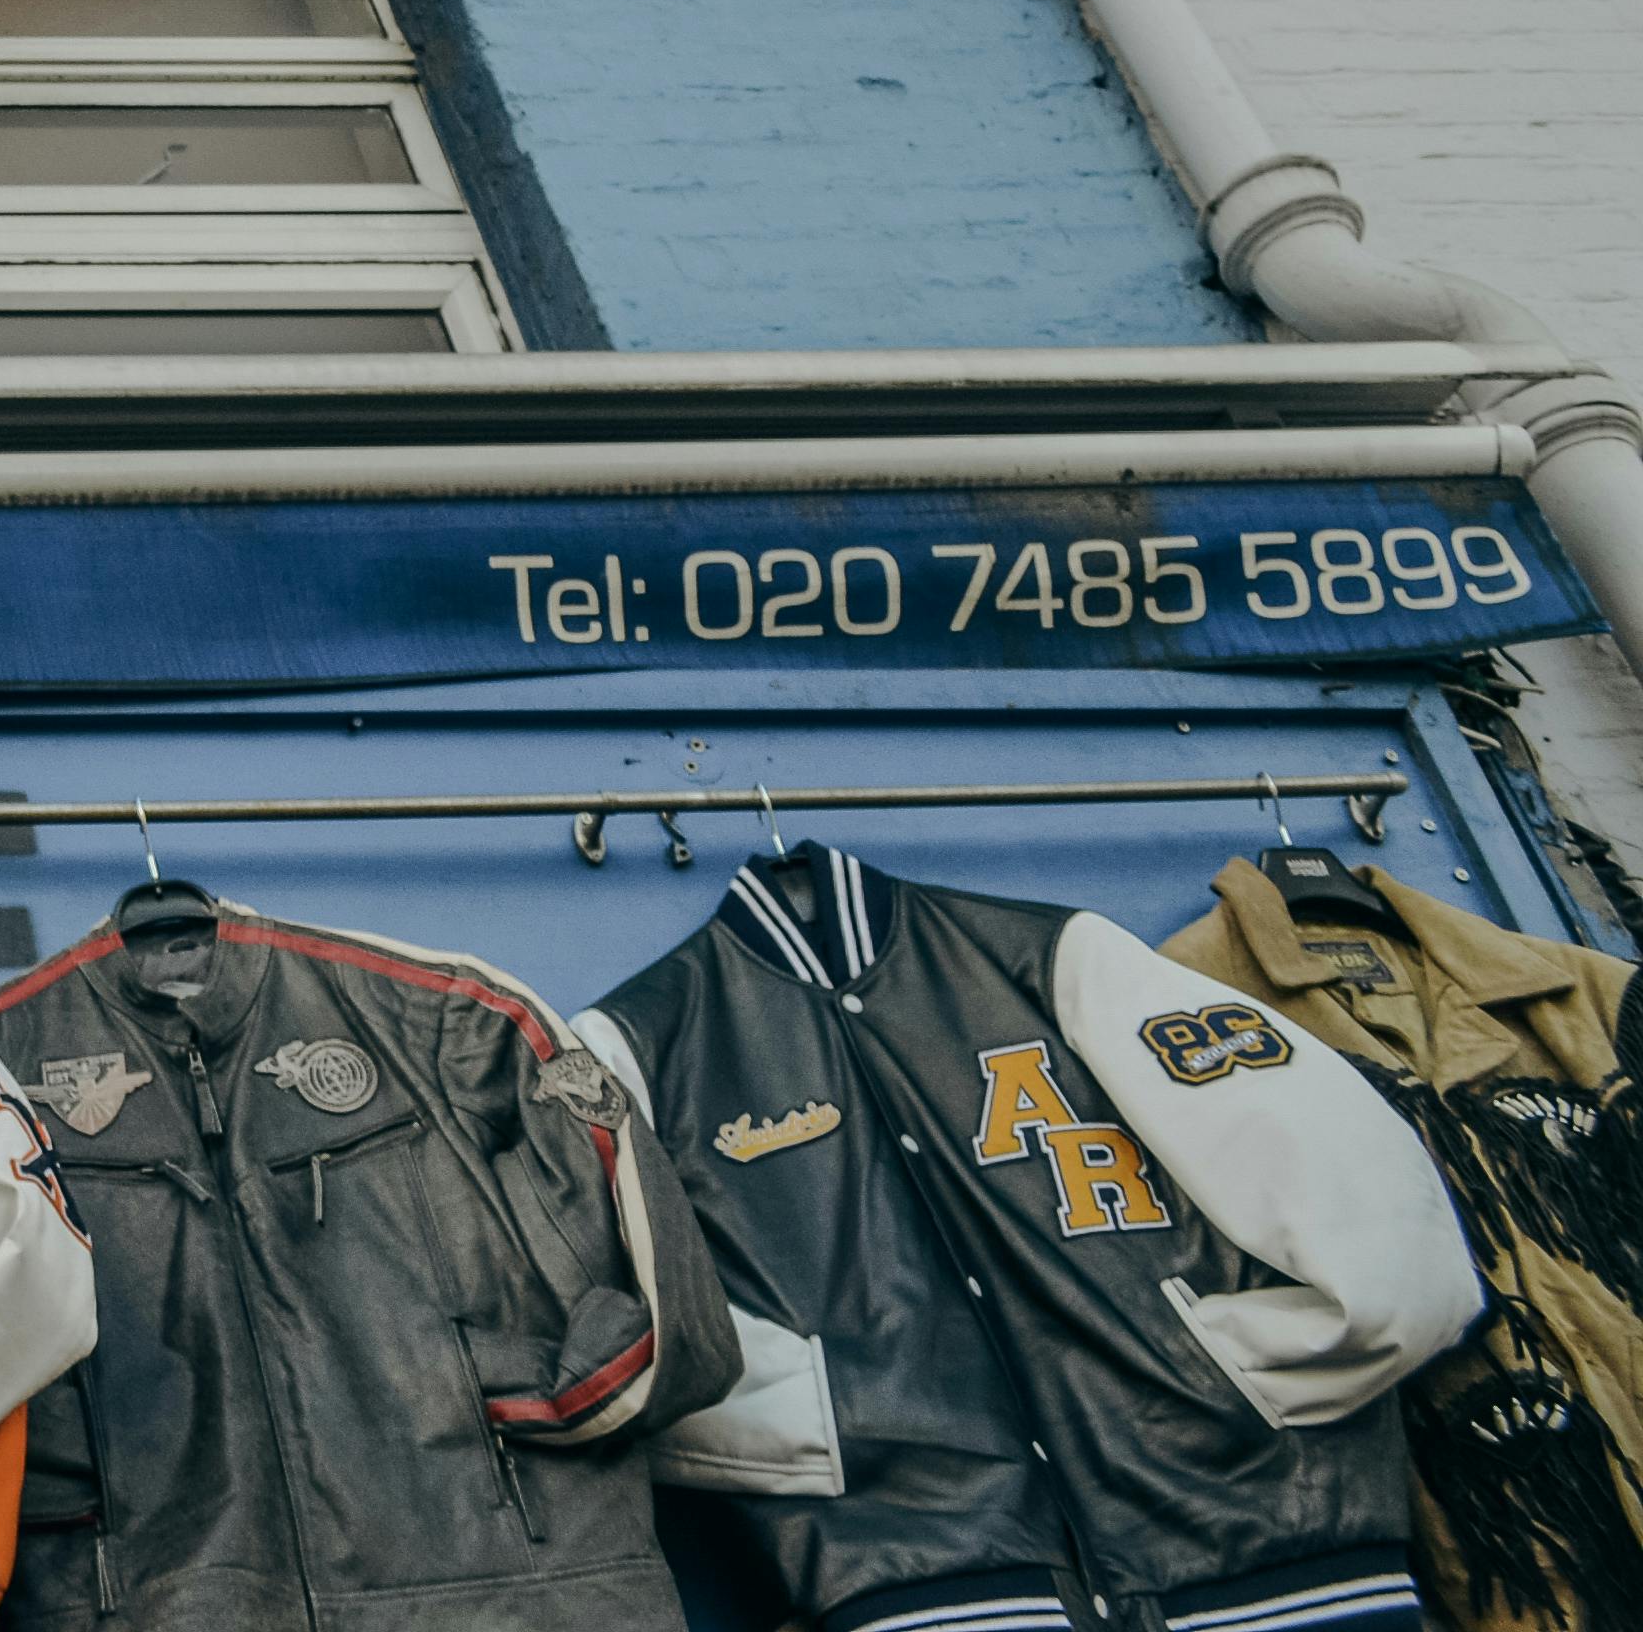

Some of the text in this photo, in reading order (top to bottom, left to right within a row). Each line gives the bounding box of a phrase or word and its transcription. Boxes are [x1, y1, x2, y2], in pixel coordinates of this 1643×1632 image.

[489, 526, 1532, 643] Tel: 020 7485 5899
[1137, 1002, 1294, 1086] 86
